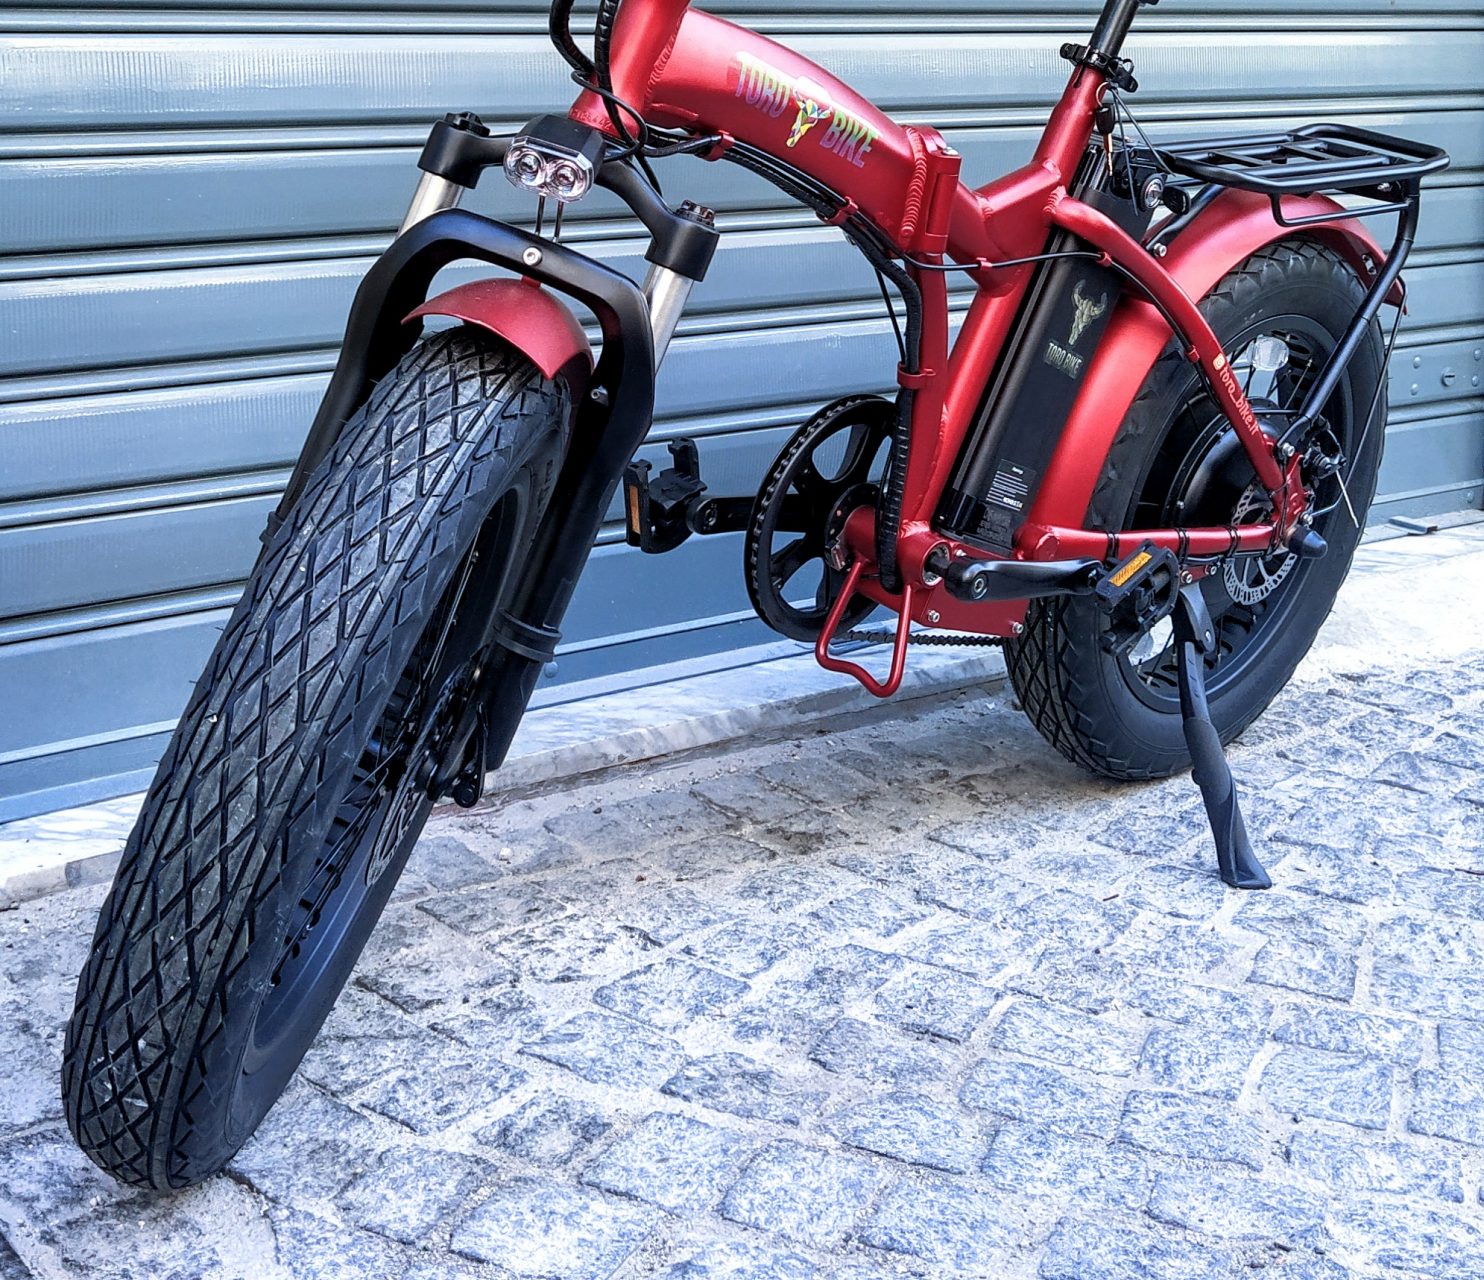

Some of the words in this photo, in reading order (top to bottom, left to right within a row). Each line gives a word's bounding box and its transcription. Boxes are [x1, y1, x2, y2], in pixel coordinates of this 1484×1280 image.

[735, 55, 791, 118] TORO
[819, 110, 880, 168] BIKE
[1045, 342, 1067, 368] TORO
[1063, 352, 1082, 375] BIKE
